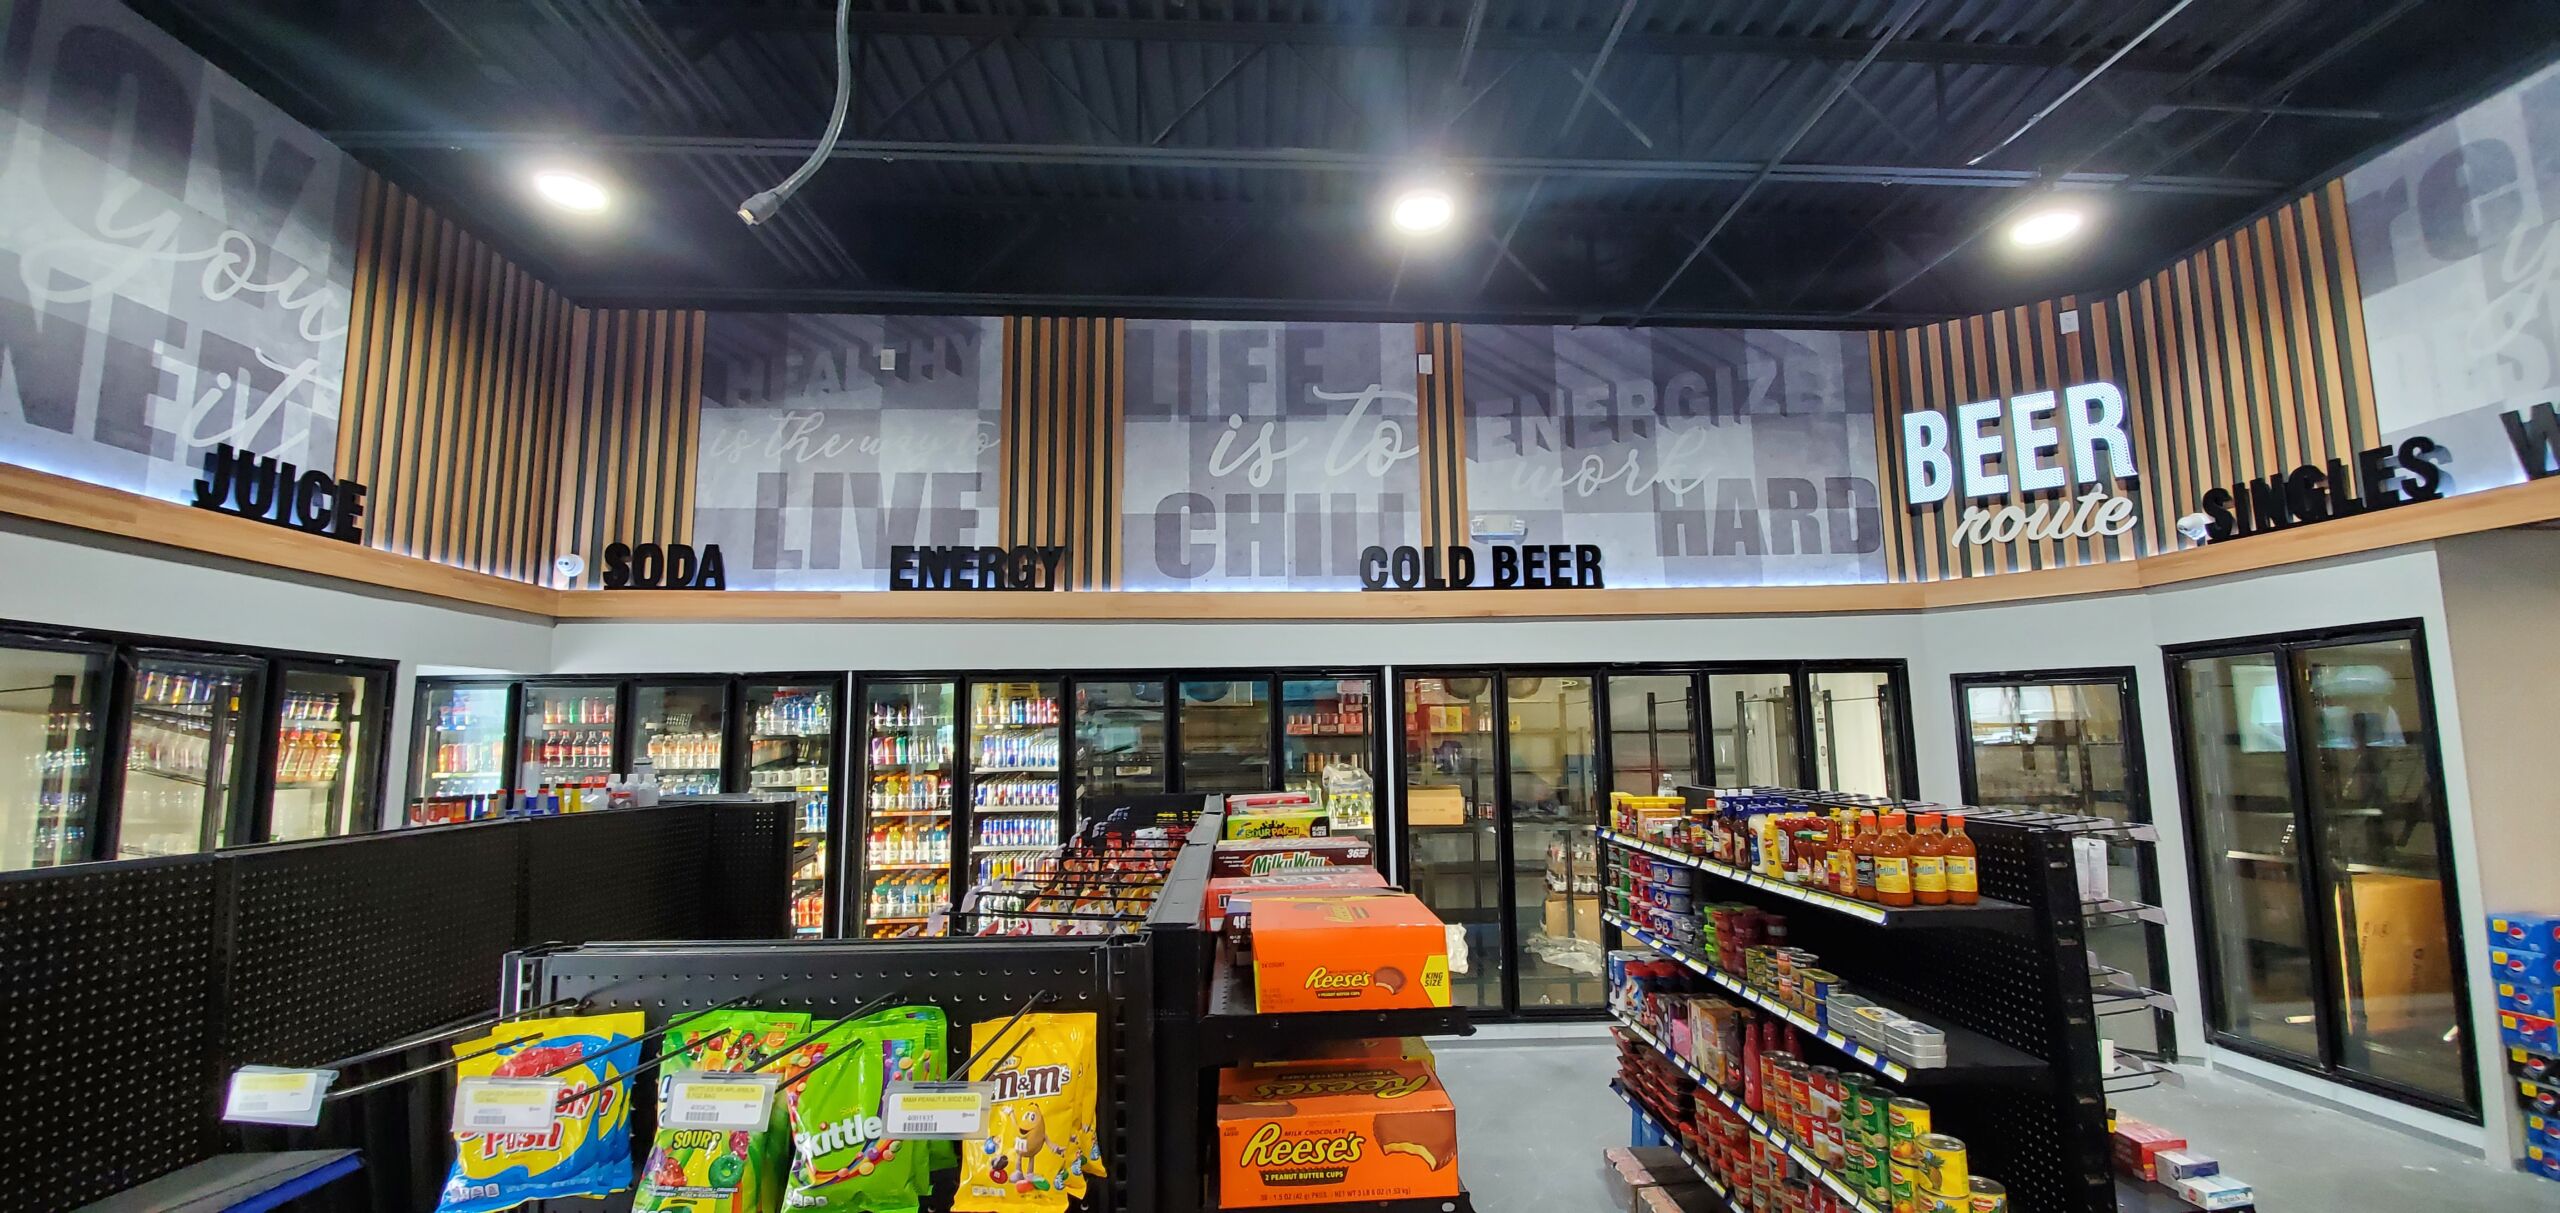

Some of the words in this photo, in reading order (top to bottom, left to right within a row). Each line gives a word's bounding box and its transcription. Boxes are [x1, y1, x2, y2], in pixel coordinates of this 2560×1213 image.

[20, 176, 349, 342] you
[724, 334, 981, 407] HEALTHY
[1124, 329, 1328, 422] LIFE
[185, 347, 338, 462] it
[709, 428, 760, 463] is
[764, 410, 854, 463] the
[1209, 414, 1308, 487] is
[1313, 384, 1419, 477] to
[1903, 382, 2138, 504] BEER
[1511, 427, 1718, 498] work
[192, 443, 367, 543] JUICE
[2202, 436, 2440, 542] SINGLES
[752, 472, 982, 569] LIVE
[1655, 477, 1880, 557] HARD
[1951, 484, 2138, 548] route
[602, 543, 725, 590] SODA
[890, 546, 1067, 591] ENERGY
[1360, 545, 1475, 590] COLD
[1492, 544, 1604, 589] BEER
[1245, 827, 1271, 839] SOUR
[1271, 826, 1300, 836] PATCH
[1347, 849, 1360, 858] 36
[1233, 916, 1247, 929] 48
[1305, 966, 1372, 989] Reese's
[1424, 979, 1442, 987] SIZE
[1425, 972, 1443, 980] KING
[672, 1130, 722, 1150] SOURS
[1240, 1122, 1365, 1168] Reese's
[1304, 1128, 1346, 1136] CHOCOLATE
[1271, 1172, 1297, 1180] PEANUT
[1299, 1171, 1324, 1179] BUTTER
